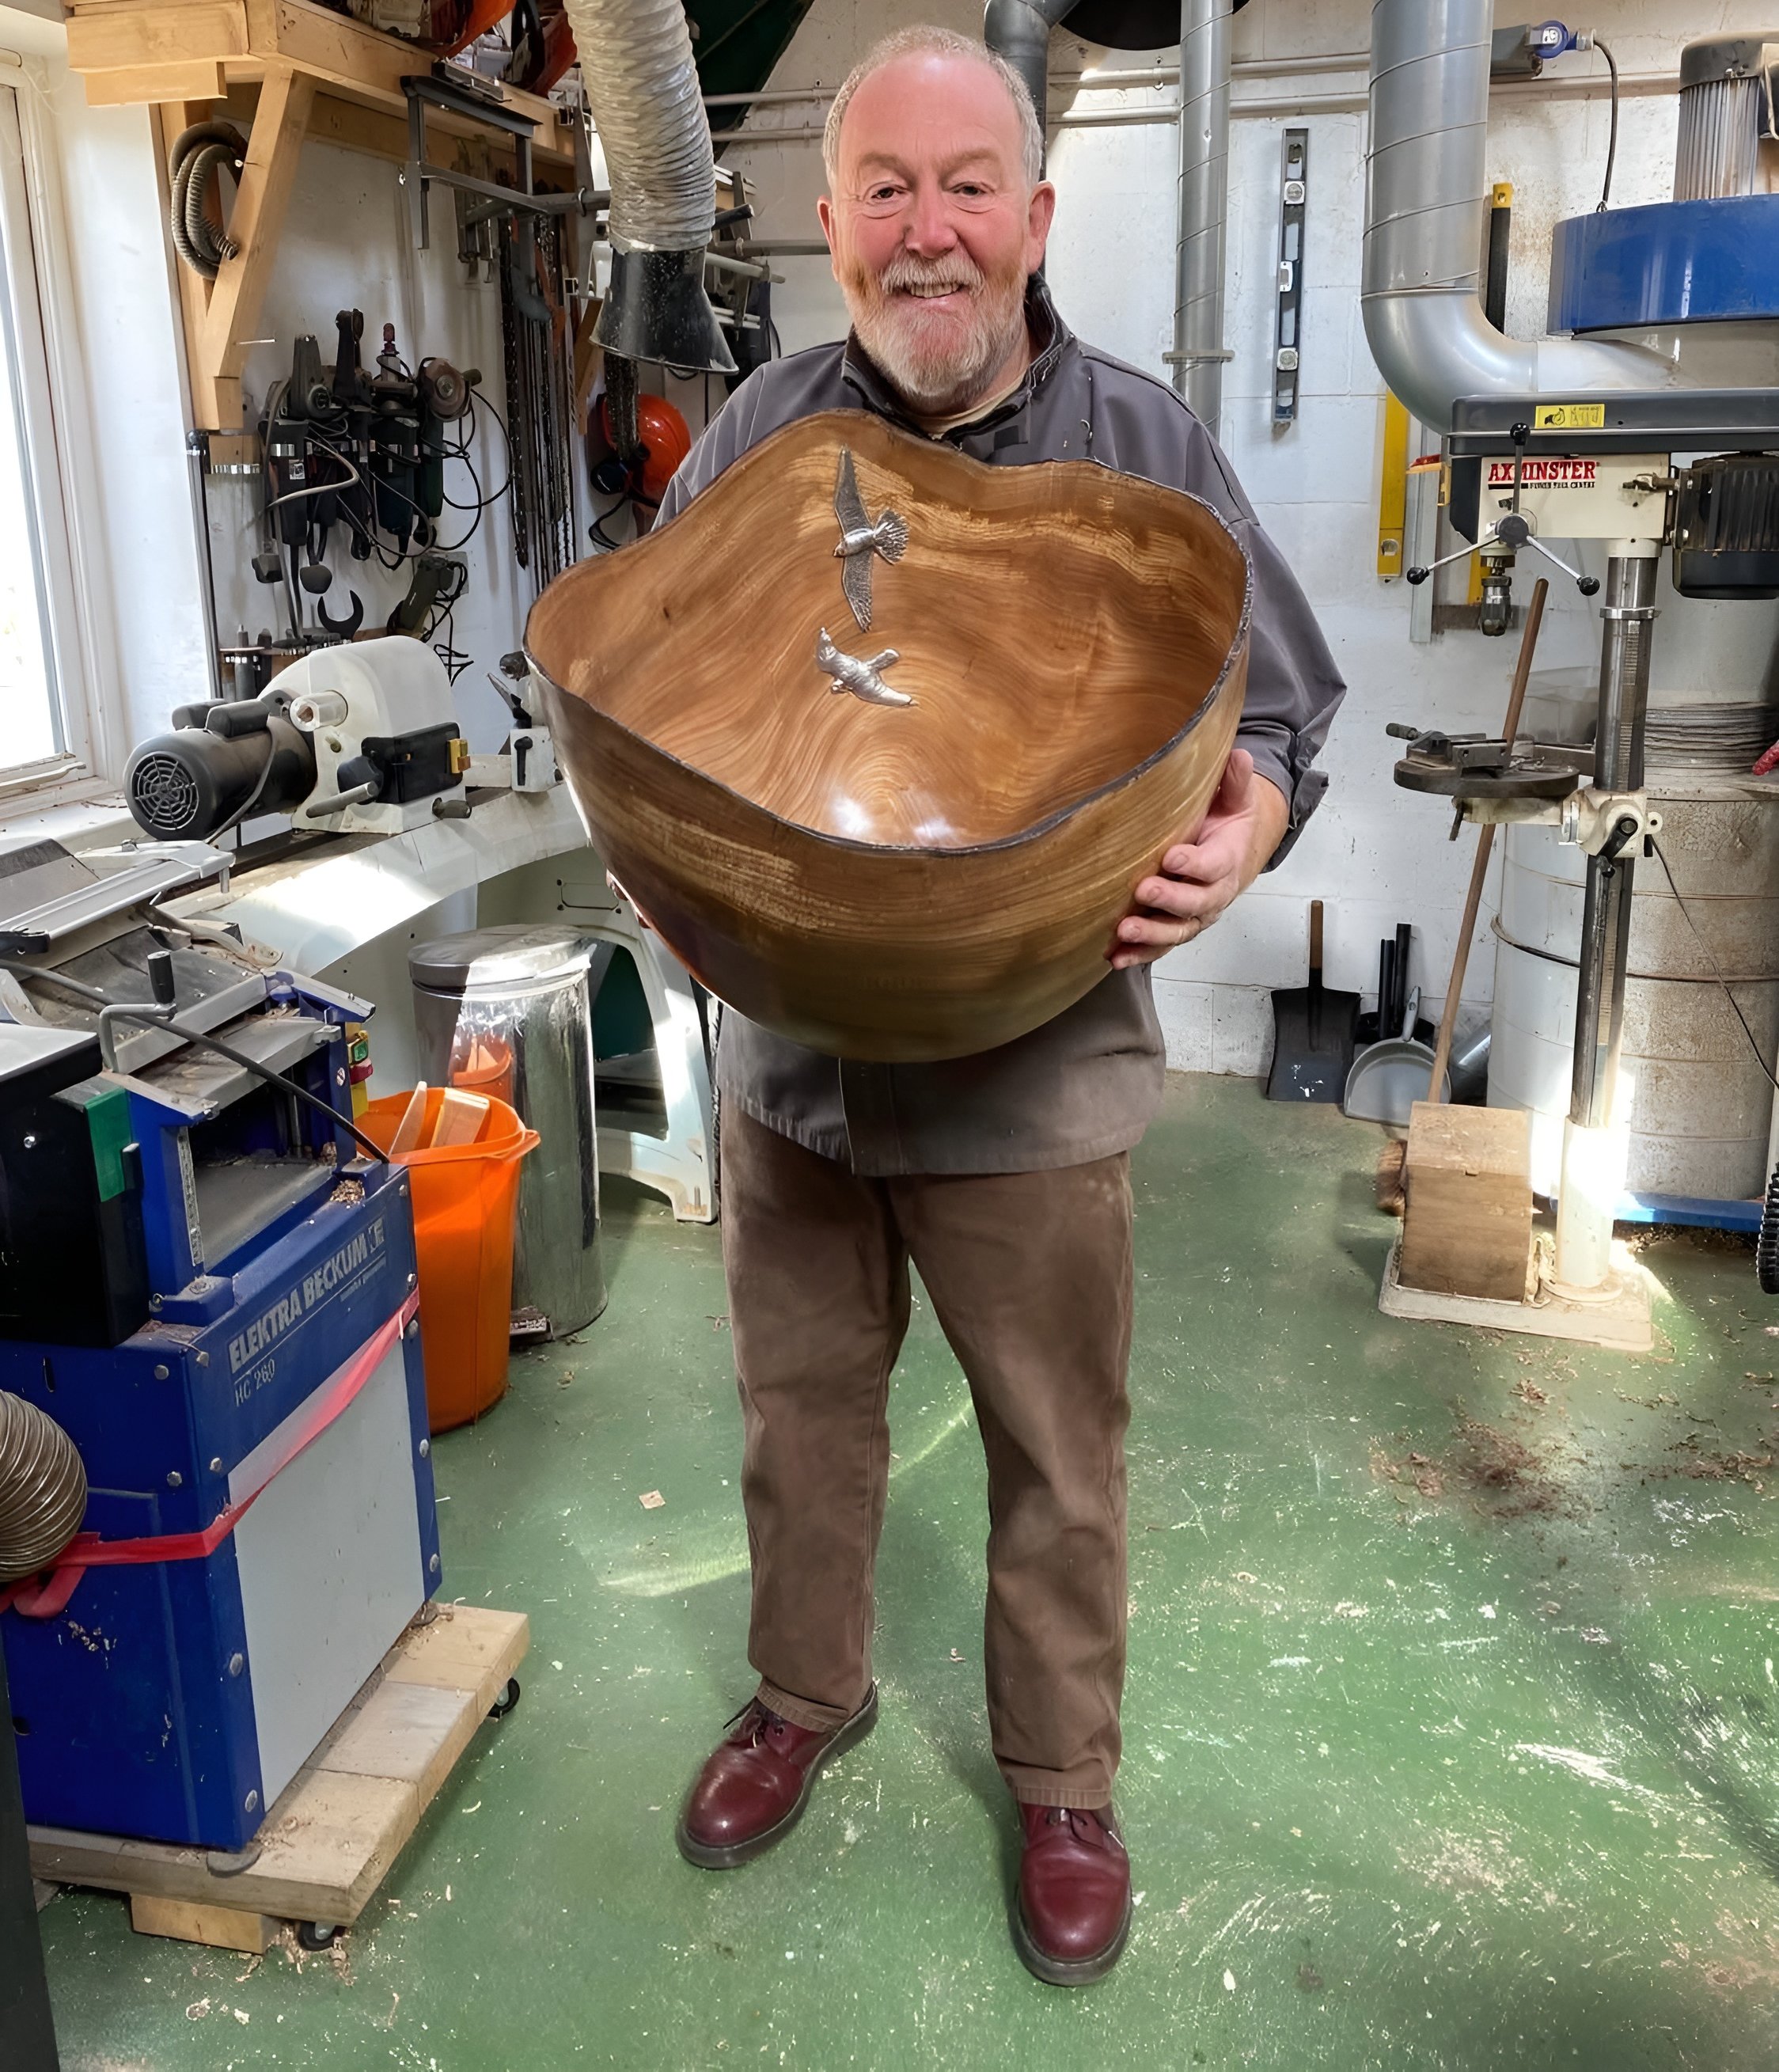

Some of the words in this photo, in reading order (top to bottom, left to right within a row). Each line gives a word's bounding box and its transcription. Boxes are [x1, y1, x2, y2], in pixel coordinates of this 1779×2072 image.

[229, 1288, 302, 1374] ELEKTRA
[302, 1232, 368, 1309] BECKUM
[235, 1379, 251, 1407] HC
